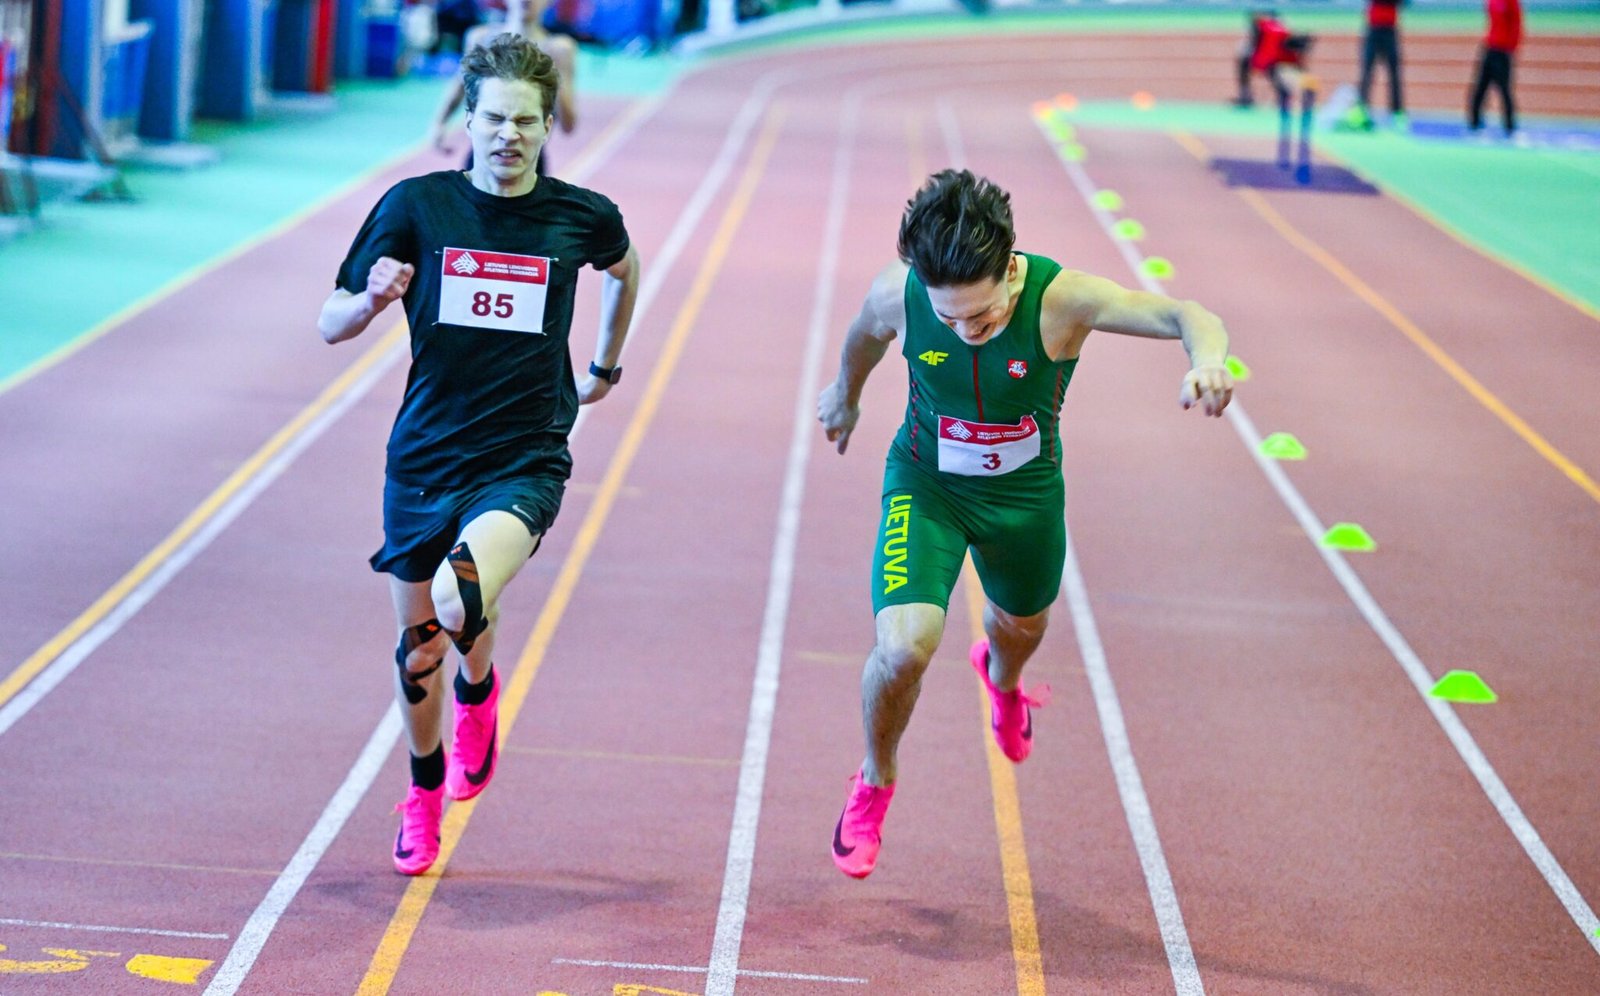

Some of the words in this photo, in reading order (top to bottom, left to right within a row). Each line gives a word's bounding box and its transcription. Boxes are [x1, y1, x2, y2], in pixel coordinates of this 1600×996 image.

[471, 291, 514, 319] 85
[918, 350, 949, 366] 4F
[981, 452, 1001, 471] 3
[883, 495, 913, 595] LIETUVA
